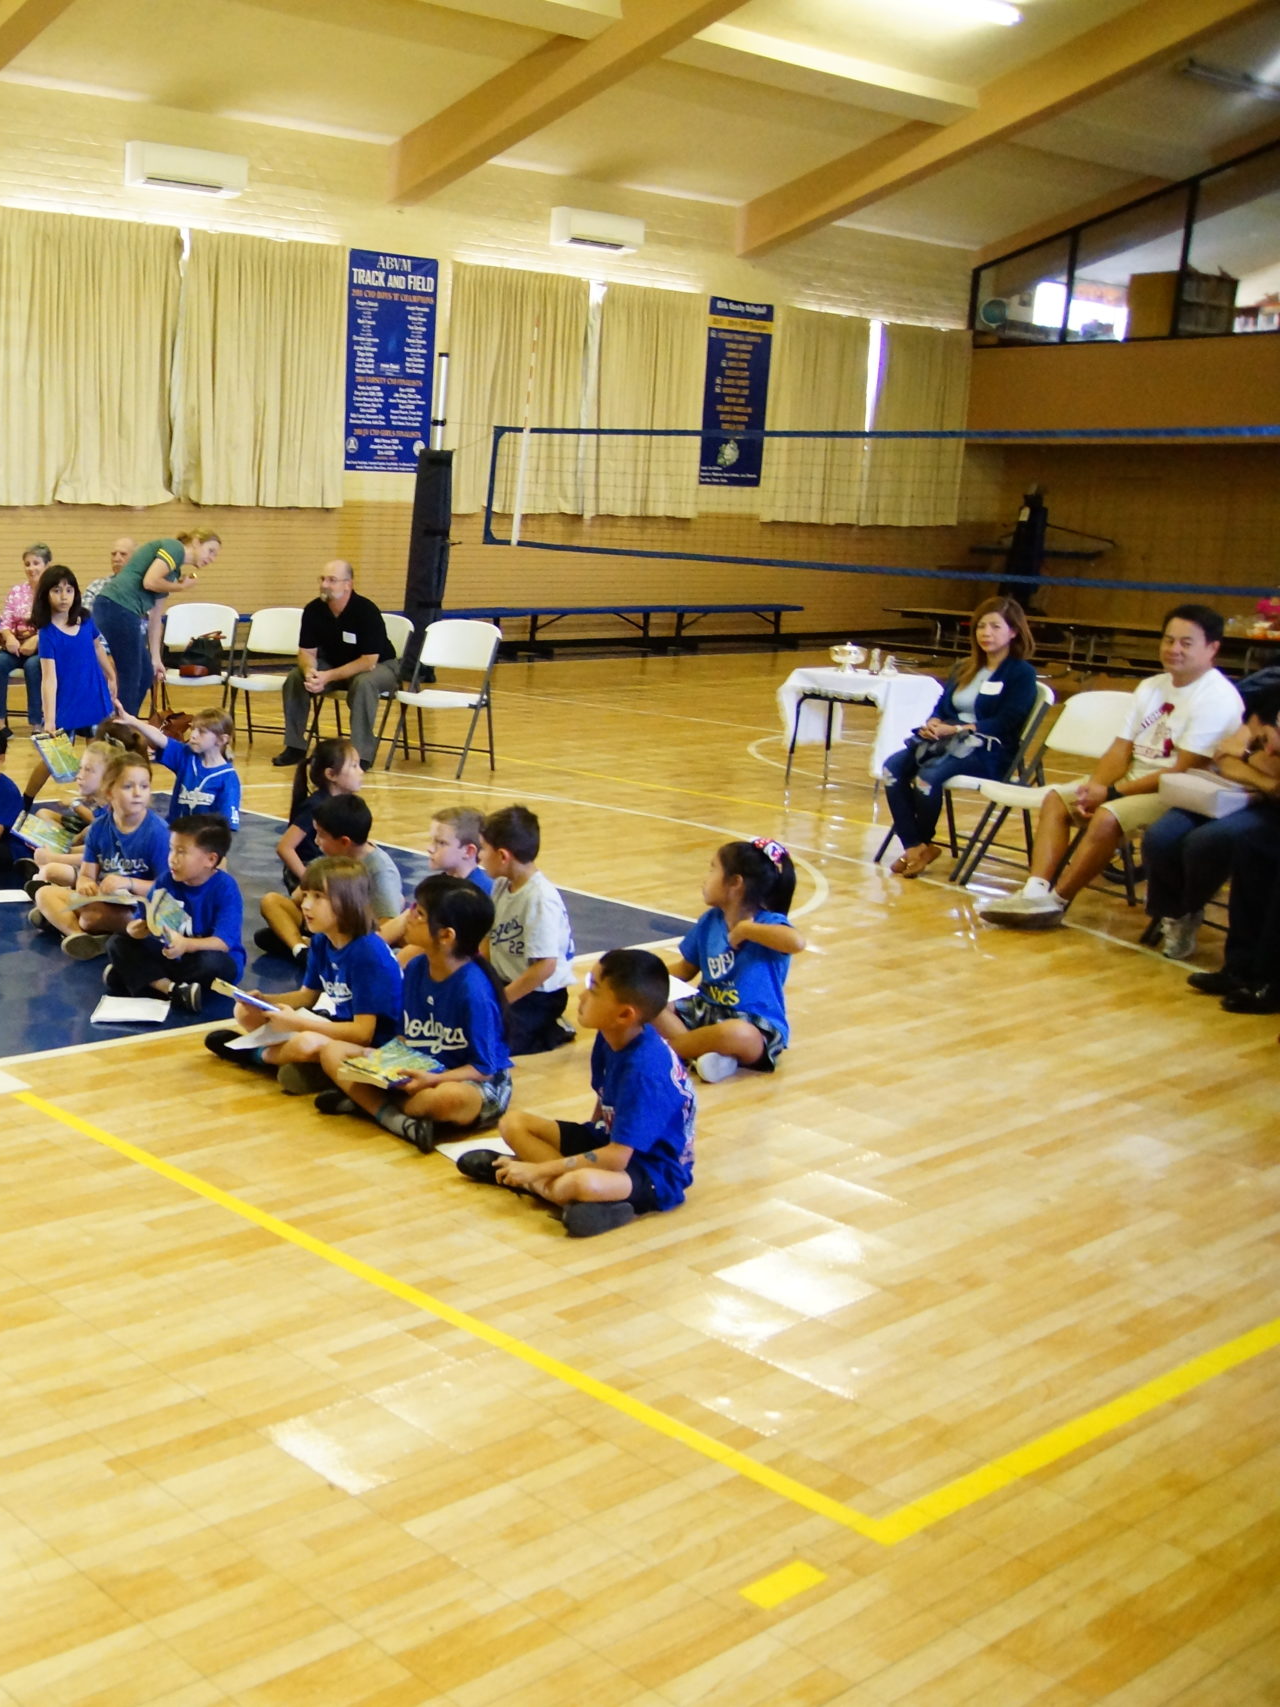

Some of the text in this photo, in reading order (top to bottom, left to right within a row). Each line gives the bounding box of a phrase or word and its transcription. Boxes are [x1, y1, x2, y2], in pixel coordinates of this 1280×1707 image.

[377, 256, 412, 272] ABVM
[352, 268, 435, 293] TRACK AND FIELD
[509, 940, 525, 955] 22
